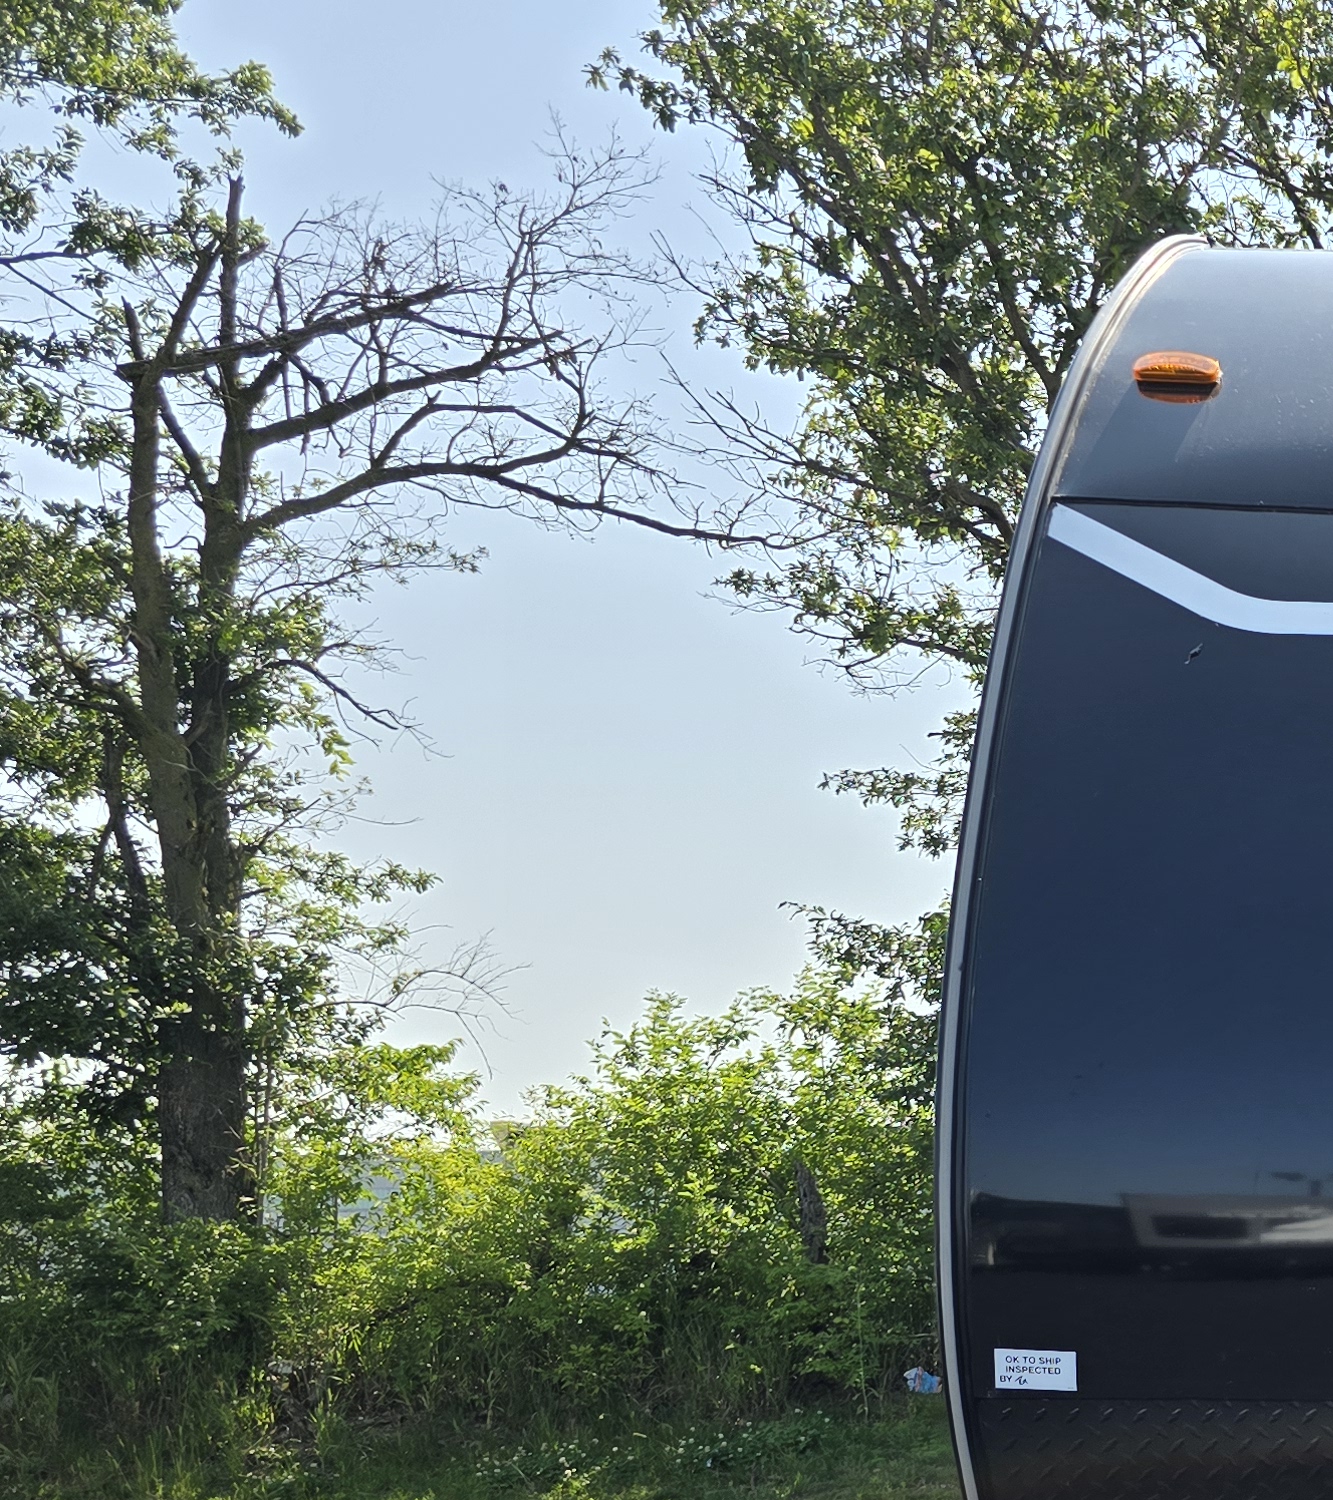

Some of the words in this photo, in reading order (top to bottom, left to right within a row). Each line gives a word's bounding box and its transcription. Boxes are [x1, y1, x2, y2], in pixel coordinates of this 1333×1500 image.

[1005, 1355, 1020, 1364] OK
[1022, 1356, 1036, 1365] TO
[1038, 1356, 1061, 1365] SHIP
[1005, 1365, 1061, 1375] INSPECTED
[999, 1374, 1013, 1383] BY
